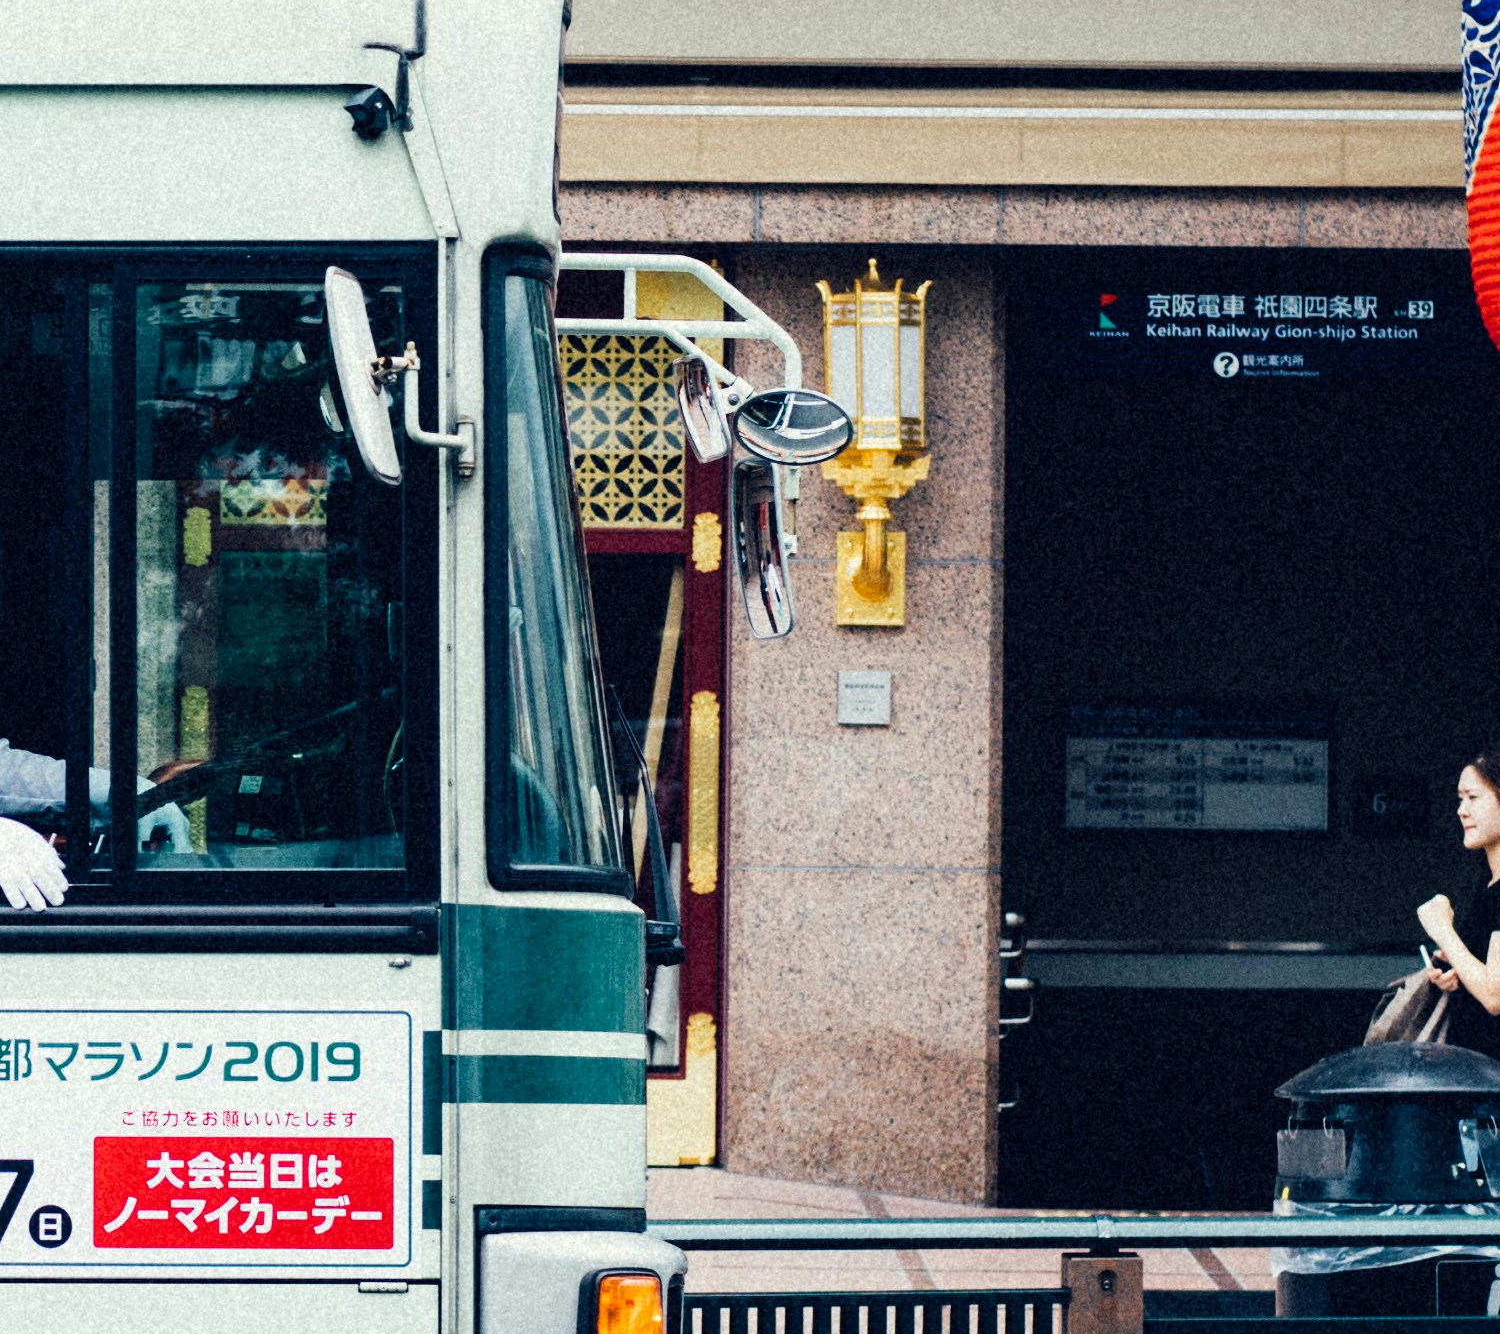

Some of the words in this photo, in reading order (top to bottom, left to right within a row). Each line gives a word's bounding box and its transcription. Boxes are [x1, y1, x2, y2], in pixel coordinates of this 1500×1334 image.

[1147, 294, 1245, 319] 京阪電車
[1254, 294, 1378, 319] 祇園四条駅
[1410, 302, 1433, 318] 39
[1146, 323, 1202, 338] Keihan
[1206, 323, 1270, 342] Railway
[1274, 323, 1357, 342] Gion-shijo
[1360, 324, 1419, 340] Station
[121, 1109, 358, 1129] ご協力をお願いいたします
[146, 1151, 343, 1190] 大会当日は
[103, 1194, 383, 1235] ノーマイカーデー
